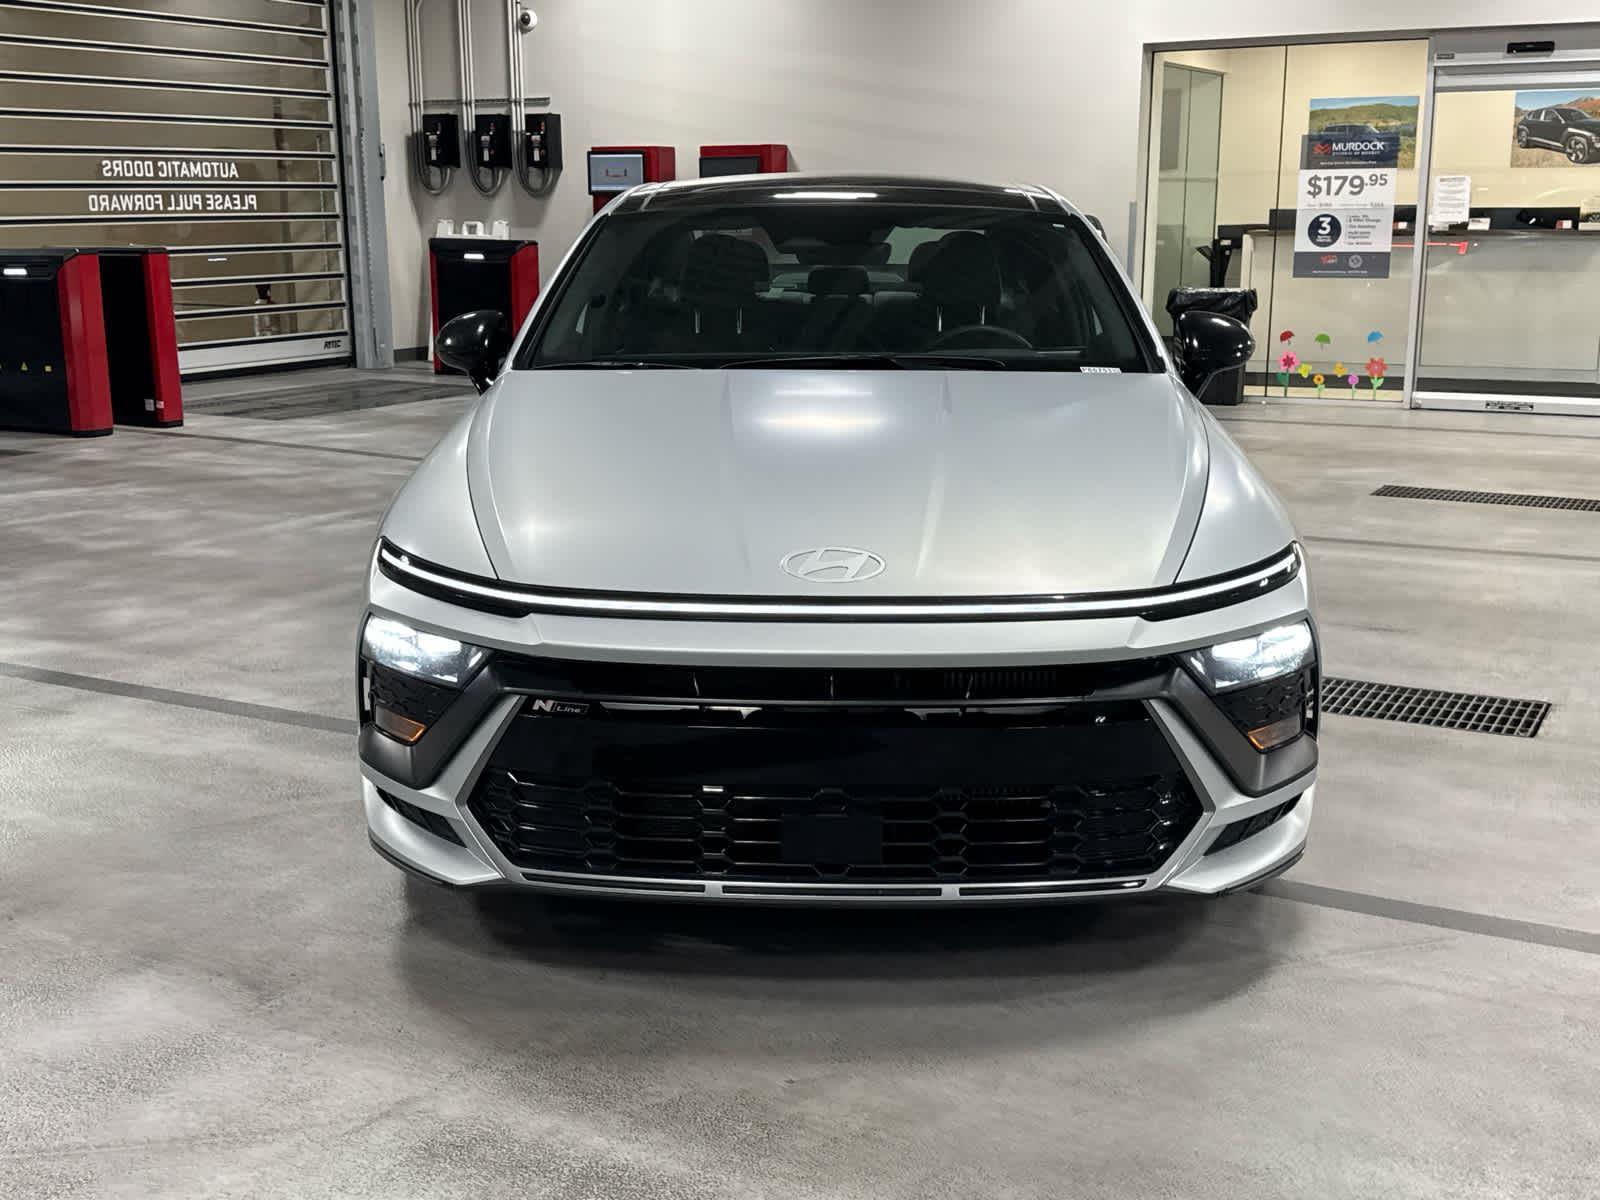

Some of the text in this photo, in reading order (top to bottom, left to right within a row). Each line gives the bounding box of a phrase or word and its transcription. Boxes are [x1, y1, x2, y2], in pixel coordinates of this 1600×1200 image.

[1332, 141, 1385, 151] MURDOCK
[1317, 216, 1332, 235] 3
[532, 699, 581, 713] N Line
